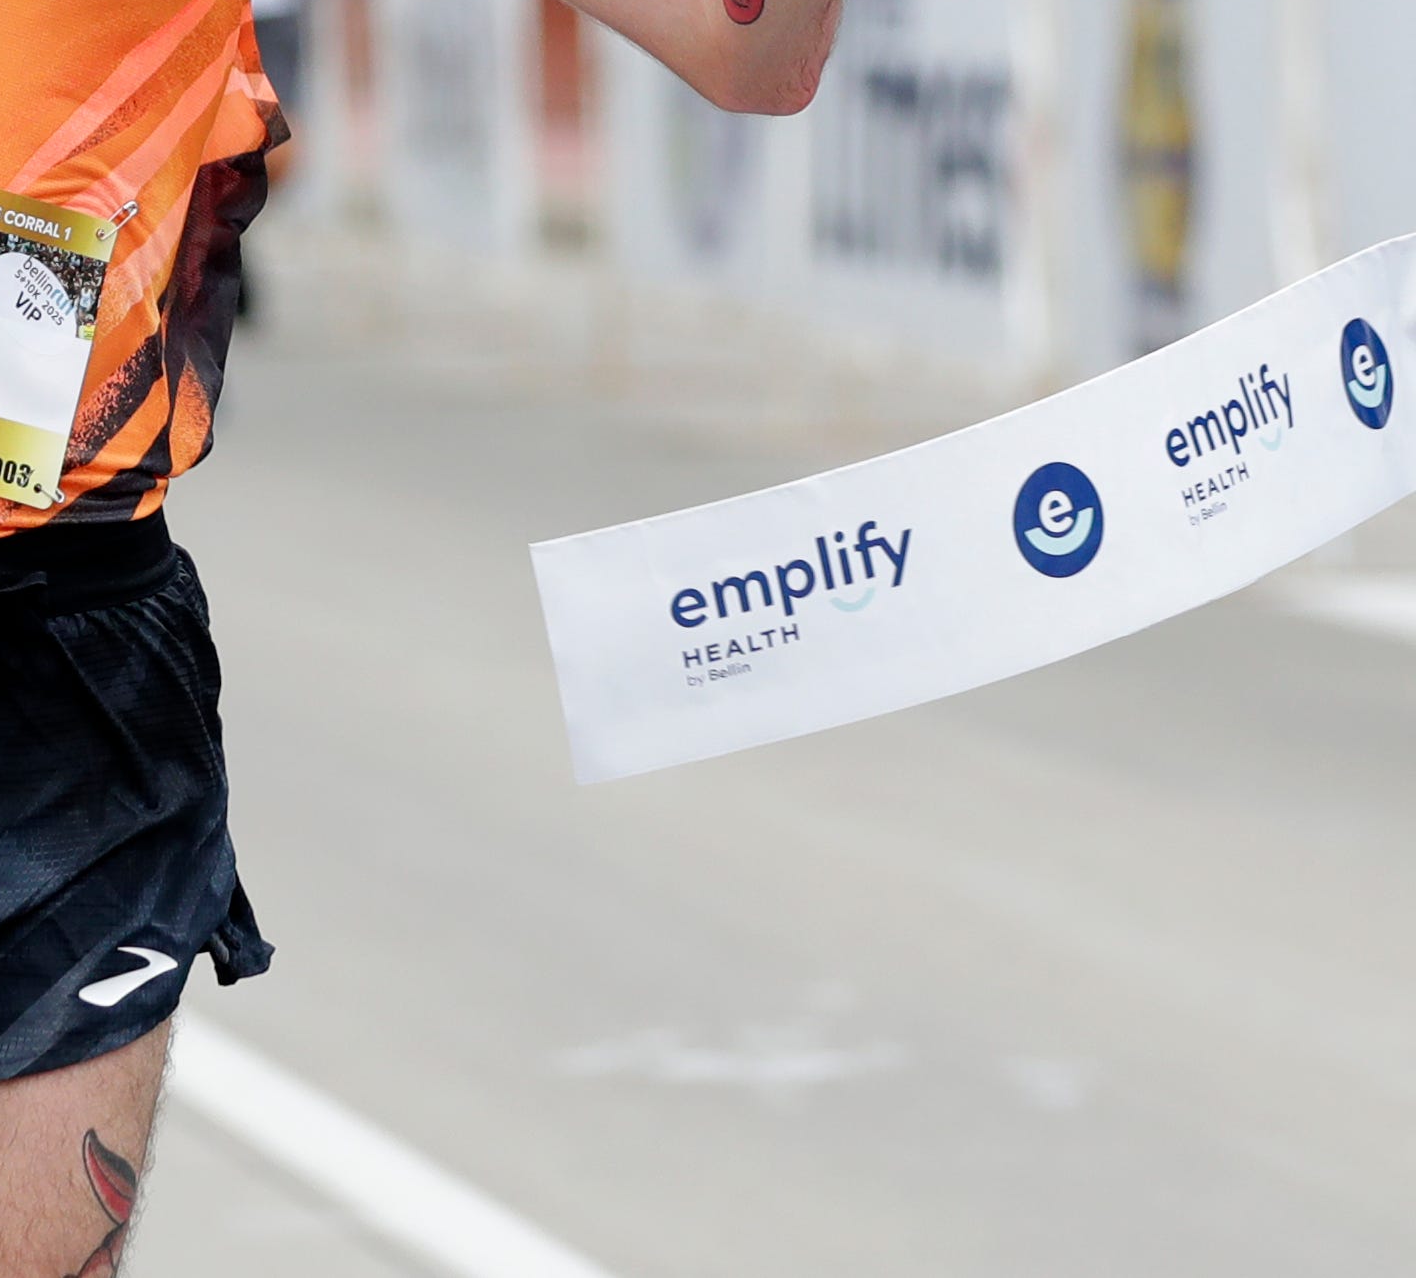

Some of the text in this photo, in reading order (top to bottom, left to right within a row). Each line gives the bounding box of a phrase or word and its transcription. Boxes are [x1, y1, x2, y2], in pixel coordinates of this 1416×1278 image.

[3, 210, 61, 239] CORRAL
[64, 226, 73, 242] 1
[14, 290, 43, 322] VIP
[41, 300, 65, 326] 2025
[1352, 344, 1378, 388] e
[1165, 363, 1295, 468] emplify
[1181, 461, 1250, 508] HEALTH
[1038, 489, 1076, 537] e
[670, 520, 913, 628] emplify
[682, 623, 801, 669] HEALTH
[685, 662, 752, 688] by Bellin
